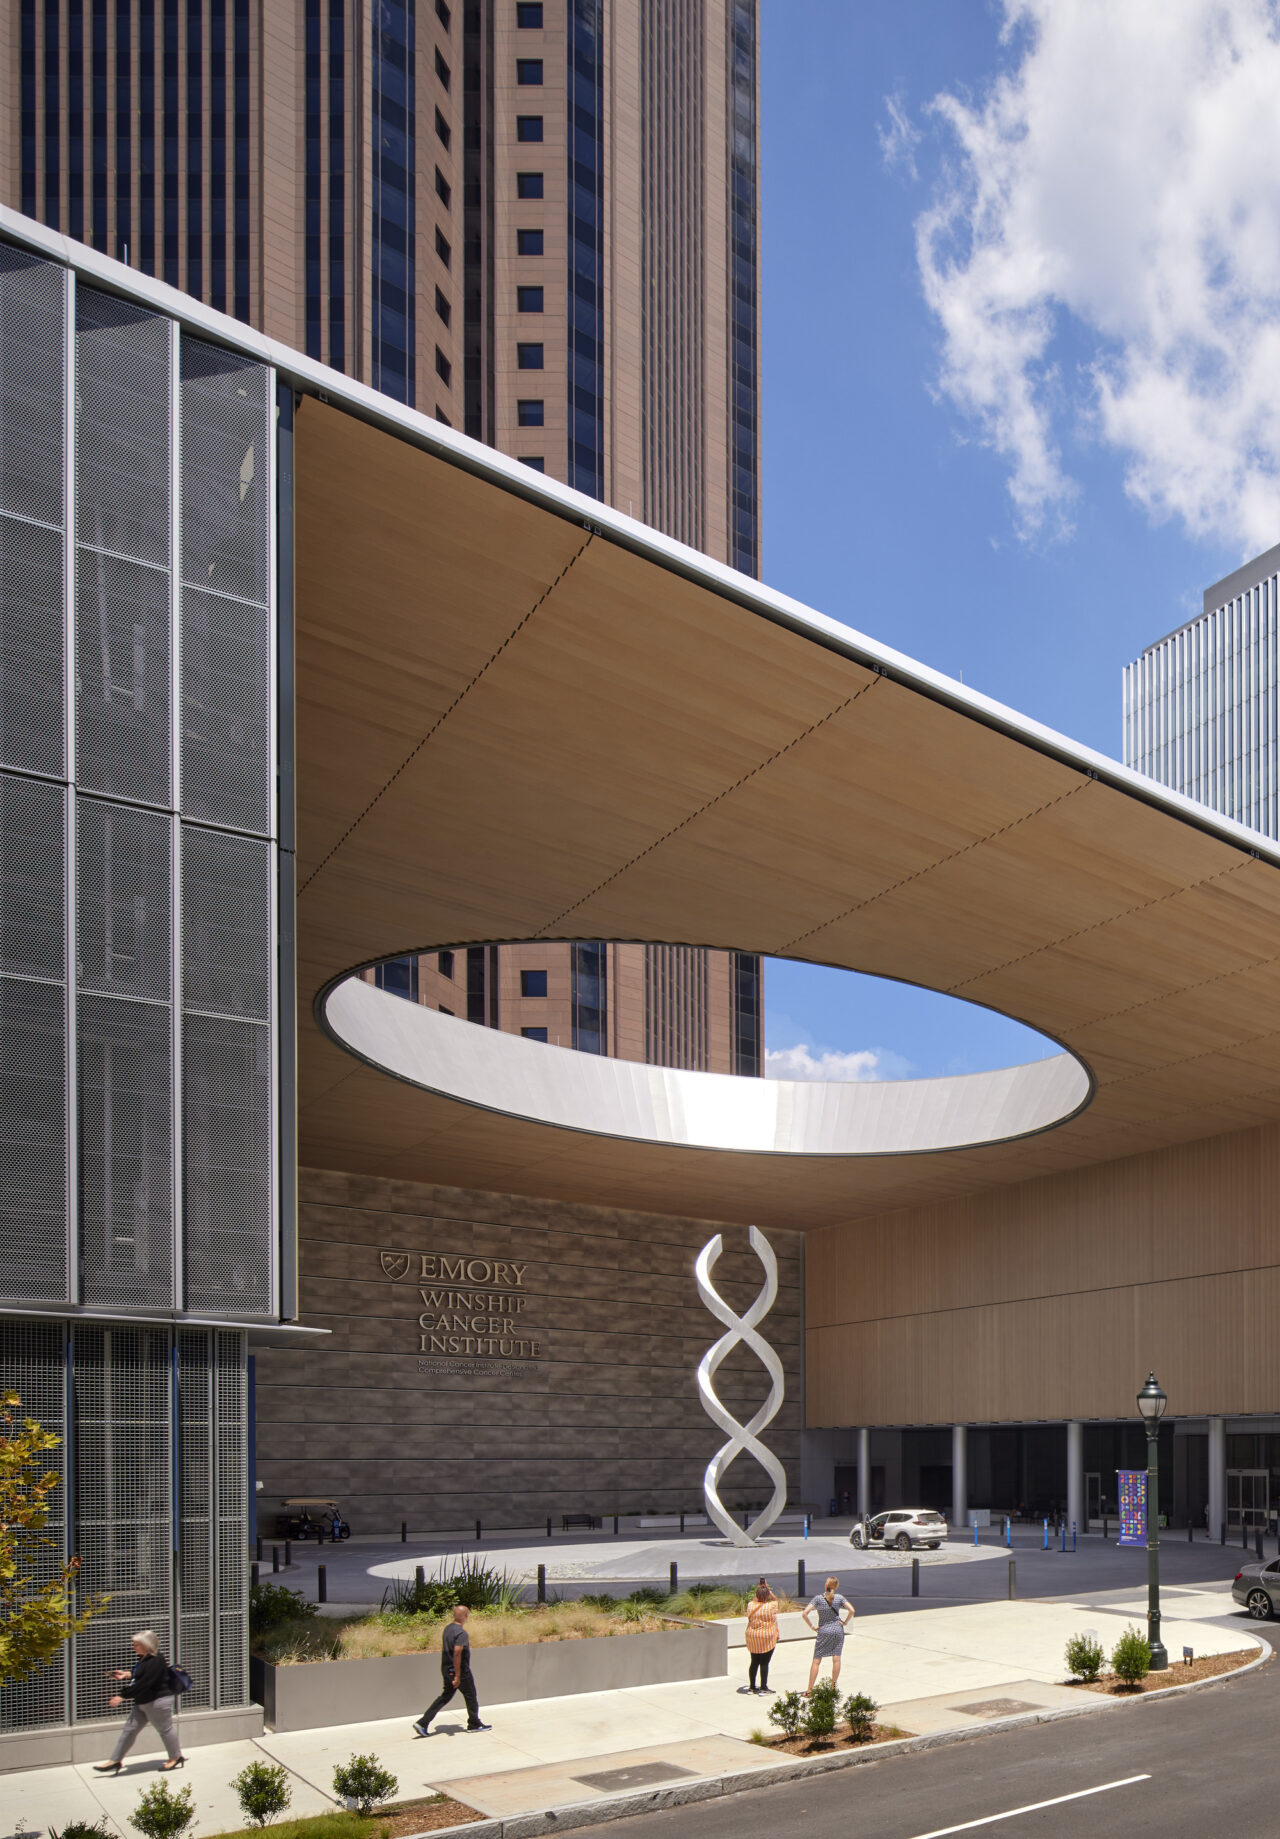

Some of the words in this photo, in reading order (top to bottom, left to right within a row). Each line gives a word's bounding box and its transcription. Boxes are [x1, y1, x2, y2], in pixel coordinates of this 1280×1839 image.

[420, 1255, 529, 1286] EMORY
[420, 1289, 527, 1314] WINSHIP
[419, 1312, 518, 1335] CANCER
[419, 1334, 542, 1358] INSTITUTE
[418, 1366, 472, 1375] Comprehensive
